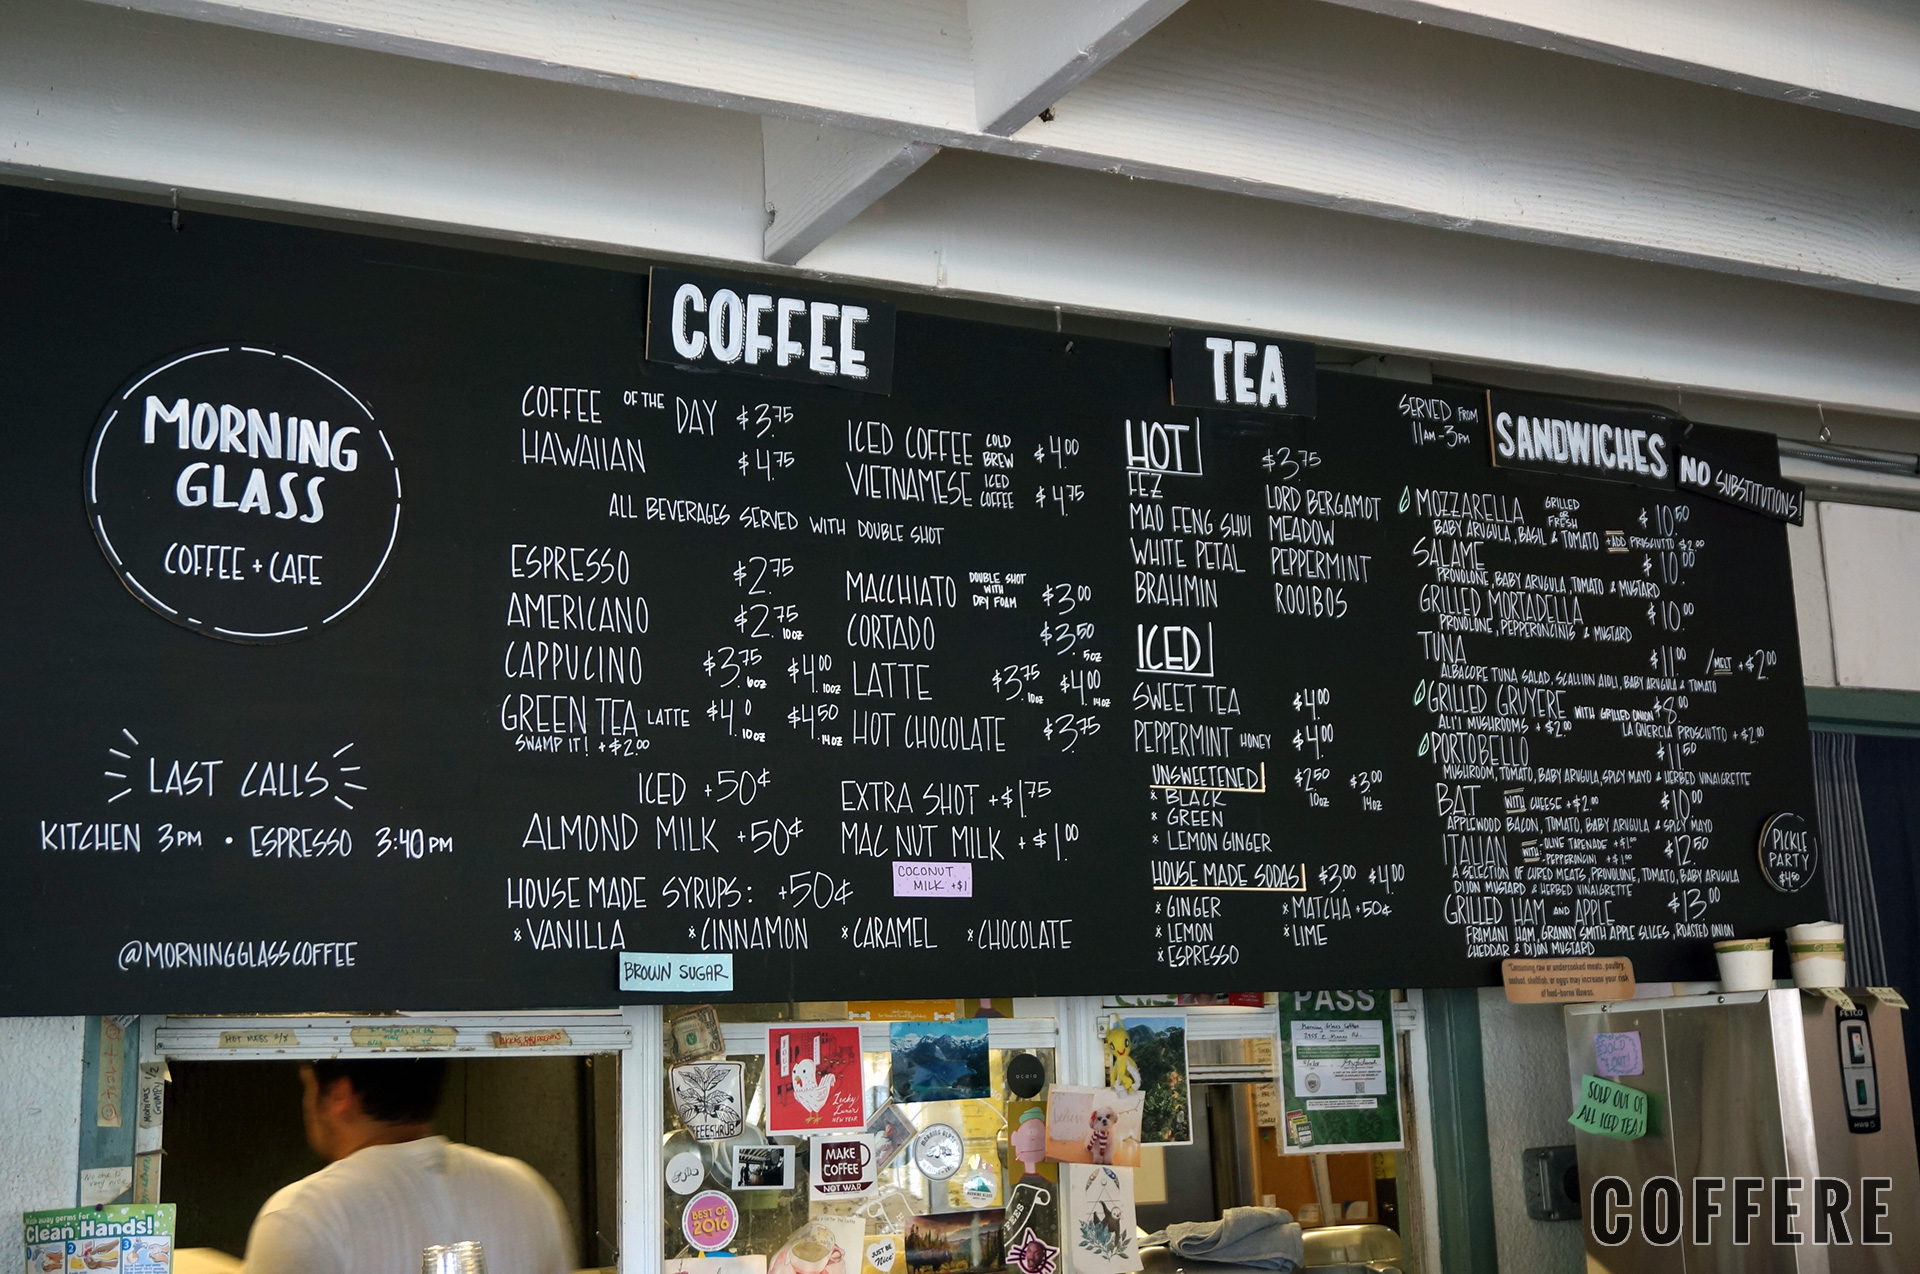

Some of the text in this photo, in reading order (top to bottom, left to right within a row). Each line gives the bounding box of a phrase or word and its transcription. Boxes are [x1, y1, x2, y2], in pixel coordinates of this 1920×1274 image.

[672, 284, 869, 379] COFFEE
[1206, 338, 1288, 408] TEA
[522, 385, 602, 423] COFFEE
[624, 391, 638, 405] OF
[641, 392, 664, 408] THE
[676, 397, 717, 435] DAY
[1399, 394, 1478, 422] SERVED FROM
[145, 395, 361, 473] MORNING
[523, 428, 645, 473] HAWAIIAN
[849, 420, 973, 465] ICED COFFEE
[986, 434, 1011, 448] COLD
[1126, 419, 1189, 472] HOT
[1495, 412, 1667, 479] SANDWICHES
[983, 451, 1013, 468] BREW
[177, 461, 327, 523] GLASS
[846, 461, 973, 506] VIETNAMESE
[985, 474, 1009, 488] ICED
[1128, 470, 1164, 498] FEZ
[1681, 455, 1804, 521] NO SUBSTITUTIONS!
[981, 491, 1014, 509] COFFEE
[1266, 484, 1381, 522] LORD BERGAMOT
[1416, 489, 1524, 526] MOZZARELLA
[1545, 496, 1580, 512] GRILLED
[609, 493, 944, 544] ALL BEVERAGES SERVED WITH DOUBLE SHOT
[1172, 506, 1213, 535] FENG
[1220, 513, 1251, 538] SHUI
[1269, 515, 1334, 545] MEADOW
[1434, 519, 1462, 537] BABY
[1548, 514, 1577, 531] FRESH
[165, 543, 322, 585] COFFEE + CAFE
[512, 544, 629, 585] ESPRESSO
[1130, 537, 1246, 572] WHITE PETAL
[1272, 547, 1371, 584] PEPPERMINT
[1413, 535, 1487, 572] SALAME
[847, 571, 956, 607] MACCHIATO
[969, 572, 1026, 585] DOUBLE SHOT
[1135, 571, 1217, 607] BRAHMIN
[507, 592, 648, 634] AMERICANO
[1276, 583, 1347, 618] ROOIBOS
[1420, 582, 1584, 626] GRILLED MORTADELLA
[848, 613, 934, 650] CORTADO
[1137, 624, 1201, 672] ICED
[1417, 629, 1467, 665] TUNA
[505, 641, 641, 684] CAPPUCINO
[853, 661, 932, 700] LATTE
[502, 694, 690, 737] GREEN TEA LATTE
[1133, 682, 1240, 715] SWEET TEA
[1428, 679, 1654, 723] GRILLED GRUYERE WITH GRILLED ONION
[515, 734, 562, 752] SWAMP
[854, 710, 1005, 751] HOT CHOCOLATE
[1135, 720, 1271, 757] PEPPERMINT HONEY
[1431, 730, 1530, 768] PORTOBELLO
[151, 758, 328, 797] LAST CALLS
[639, 773, 686, 806] ICED
[1151, 764, 1260, 791] UNSWEETENED
[841, 781, 979, 815] EXTRA SHOT
[1530, 797, 1562, 810] CHEESE
[522, 813, 719, 853] ALMOND MILK
[1168, 810, 1223, 827] GREEN
[41, 821, 140, 852] KITCHEN
[251, 826, 352, 858] ESPRESSO
[952, 826, 1004, 860] MILK
[1443, 834, 1508, 868] ITALIAN
[1772, 828, 1807, 853] PICKLE
[897, 865, 955, 879] COCONUT
[1253, 864, 1300, 889] SODAS
[1769, 850, 1809, 870] PARTY
[589, 876, 752, 910] MADE SYRUPS:
[912, 879, 946, 894] MILK
[1167, 895, 1221, 918] GINGER
[1445, 893, 1615, 926] GRILLED HAM APPLE
[527, 916, 1072, 950] VANILLA CINNAMON CARAMEL CHOCOLATE
[1468, 941, 1595, 958] CHEDDAR DIJON MUSTARD
[119, 940, 357, 970] @MORNINGGLASSCOFFEE
[624, 961, 729, 981] BROWN SUGAR
[1168, 945, 1239, 967] ESPRESSO
[1601, 1040, 1625, 1054] SOLD
[1588, 1081, 1630, 1109] SOLD OUT
[1576, 1104, 1643, 1136] ALL ICED TEA!
[824, 1163, 859, 1176] COFFEE
[826, 1148, 856, 1160] MAKE
[843, 1184, 861, 1192] WAR
[26, 1216, 153, 1242] Clean Hands!
[55, 1214, 76, 1223] germs
[692, 1207, 727, 1220] BEST OF
[693, 1216, 729, 1235] 2016
[872, 1244, 892, 1258] JUST BE
